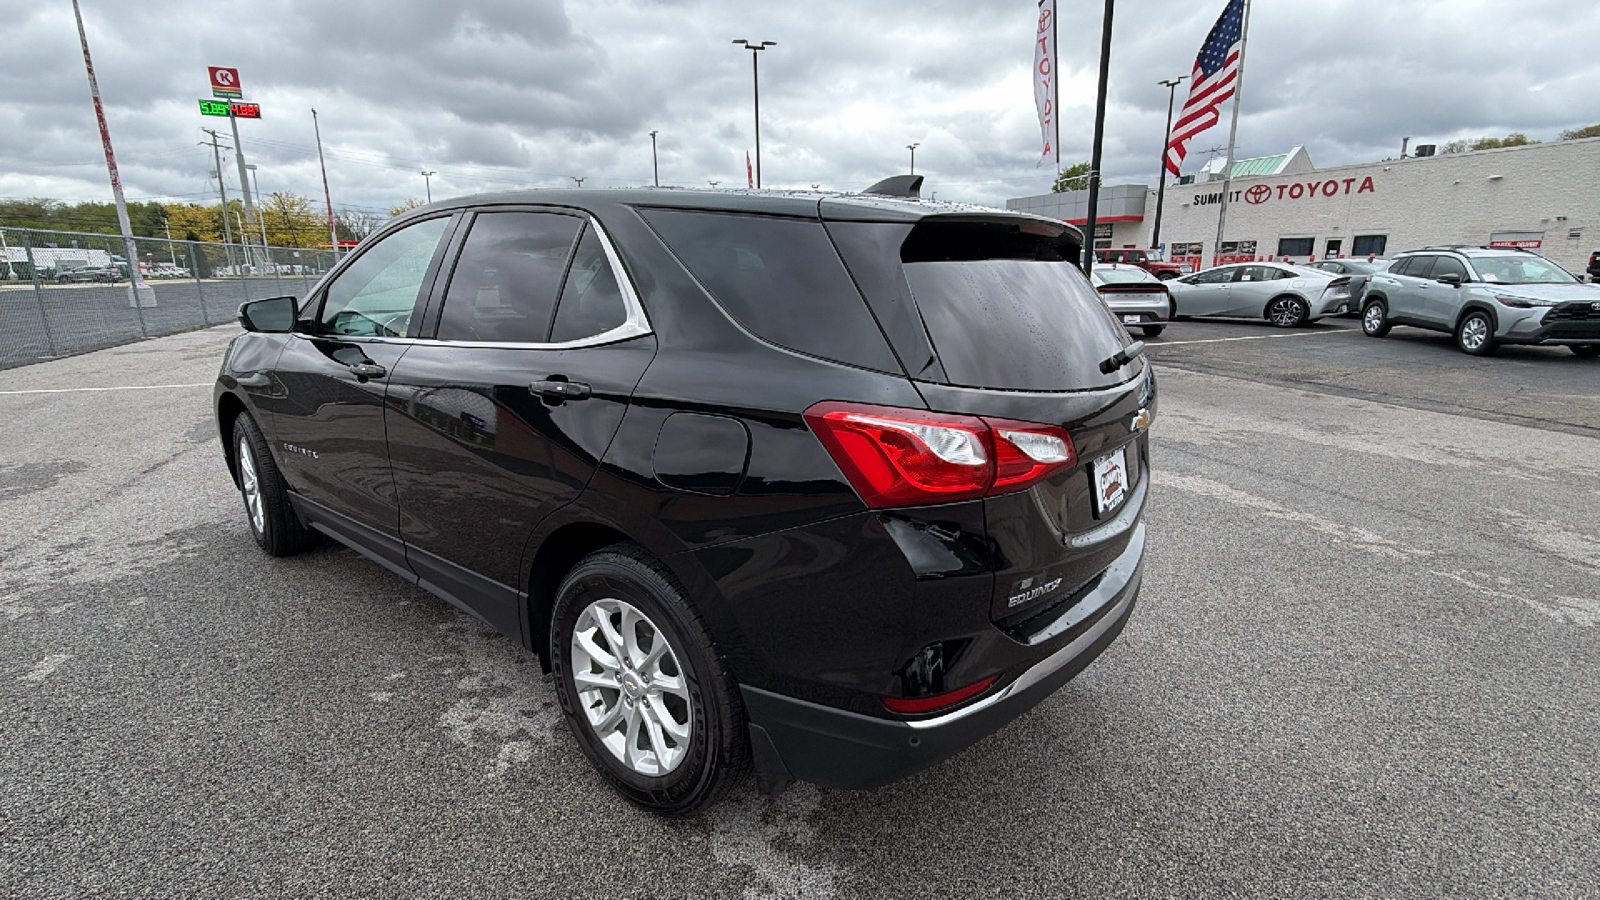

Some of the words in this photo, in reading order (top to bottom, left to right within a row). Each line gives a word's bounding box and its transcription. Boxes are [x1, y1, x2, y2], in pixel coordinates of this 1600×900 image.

[1038, 36, 1052, 156] TOYOTA
[1276, 176, 1375, 200] TOYOTA
[1008, 577, 1063, 608] EQUINOX
